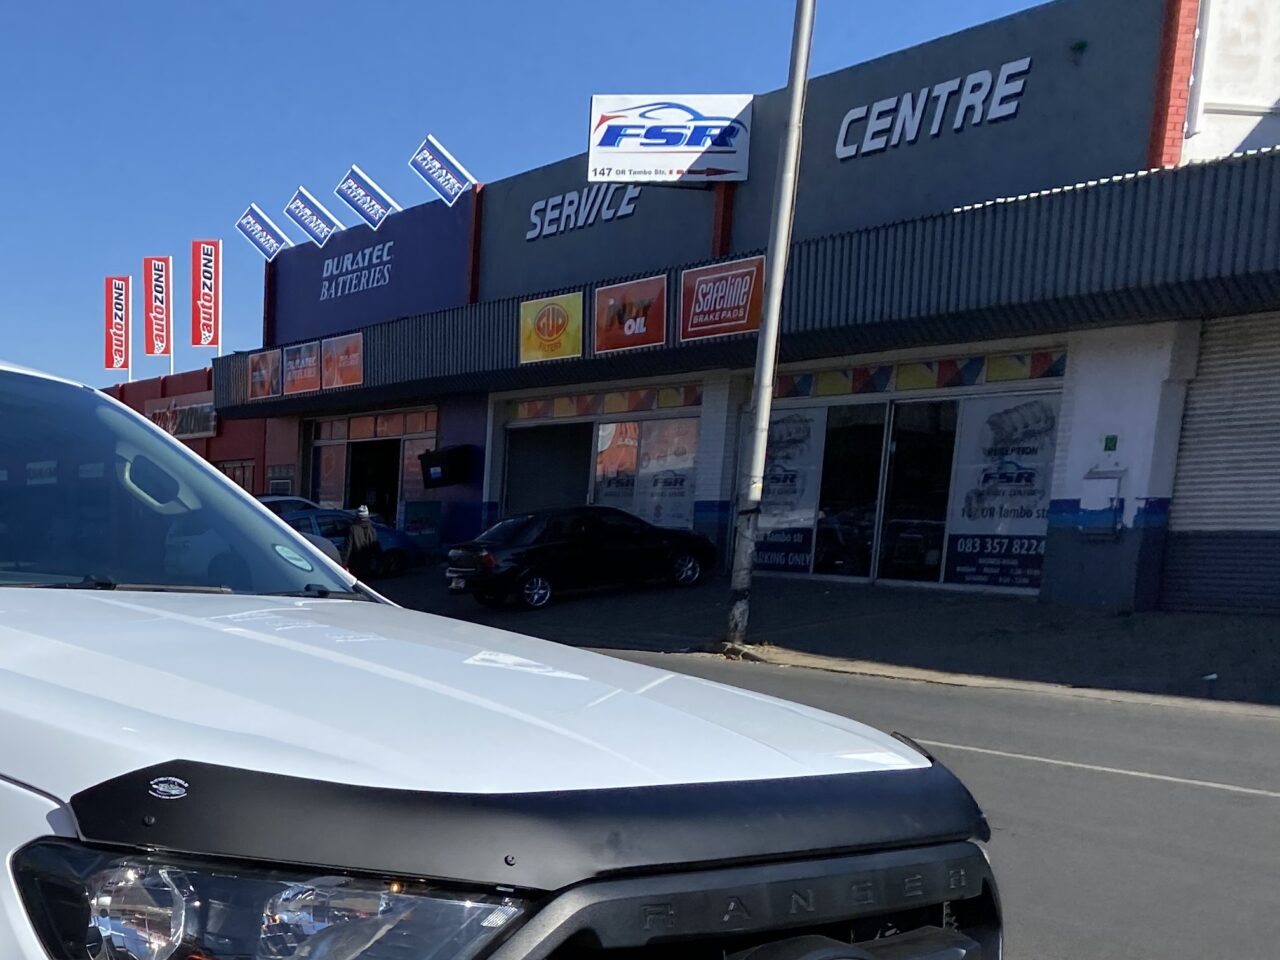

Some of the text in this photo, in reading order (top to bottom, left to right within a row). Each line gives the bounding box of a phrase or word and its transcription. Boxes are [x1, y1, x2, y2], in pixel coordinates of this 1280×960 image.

[834, 57, 1031, 160] CENTRE
[597, 124, 741, 148] FSR
[415, 153, 460, 196] BATTERIES
[420, 149, 463, 191] DURATEC
[592, 167, 612, 177] 147
[628, 168, 653, 176] Tambo
[340, 182, 384, 221] BATTERIES
[345, 178, 386, 218] DURATEC
[526, 183, 642, 241] SERVICE
[293, 199, 331, 236] DURATEC
[322, 241, 394, 278] DURATEC
[320, 264, 392, 301] BATTERIES
[623, 317, 647, 336] OIL
[693, 307, 745, 324] BRAKE PADS
[652, 477, 687, 488] FSR
[981, 471, 1036, 485] FSR
[752, 551, 811, 566] ARKING ONLY
[957, 537, 1046, 555] 083 357 8224
[640, 866, 968, 932] RANGER
